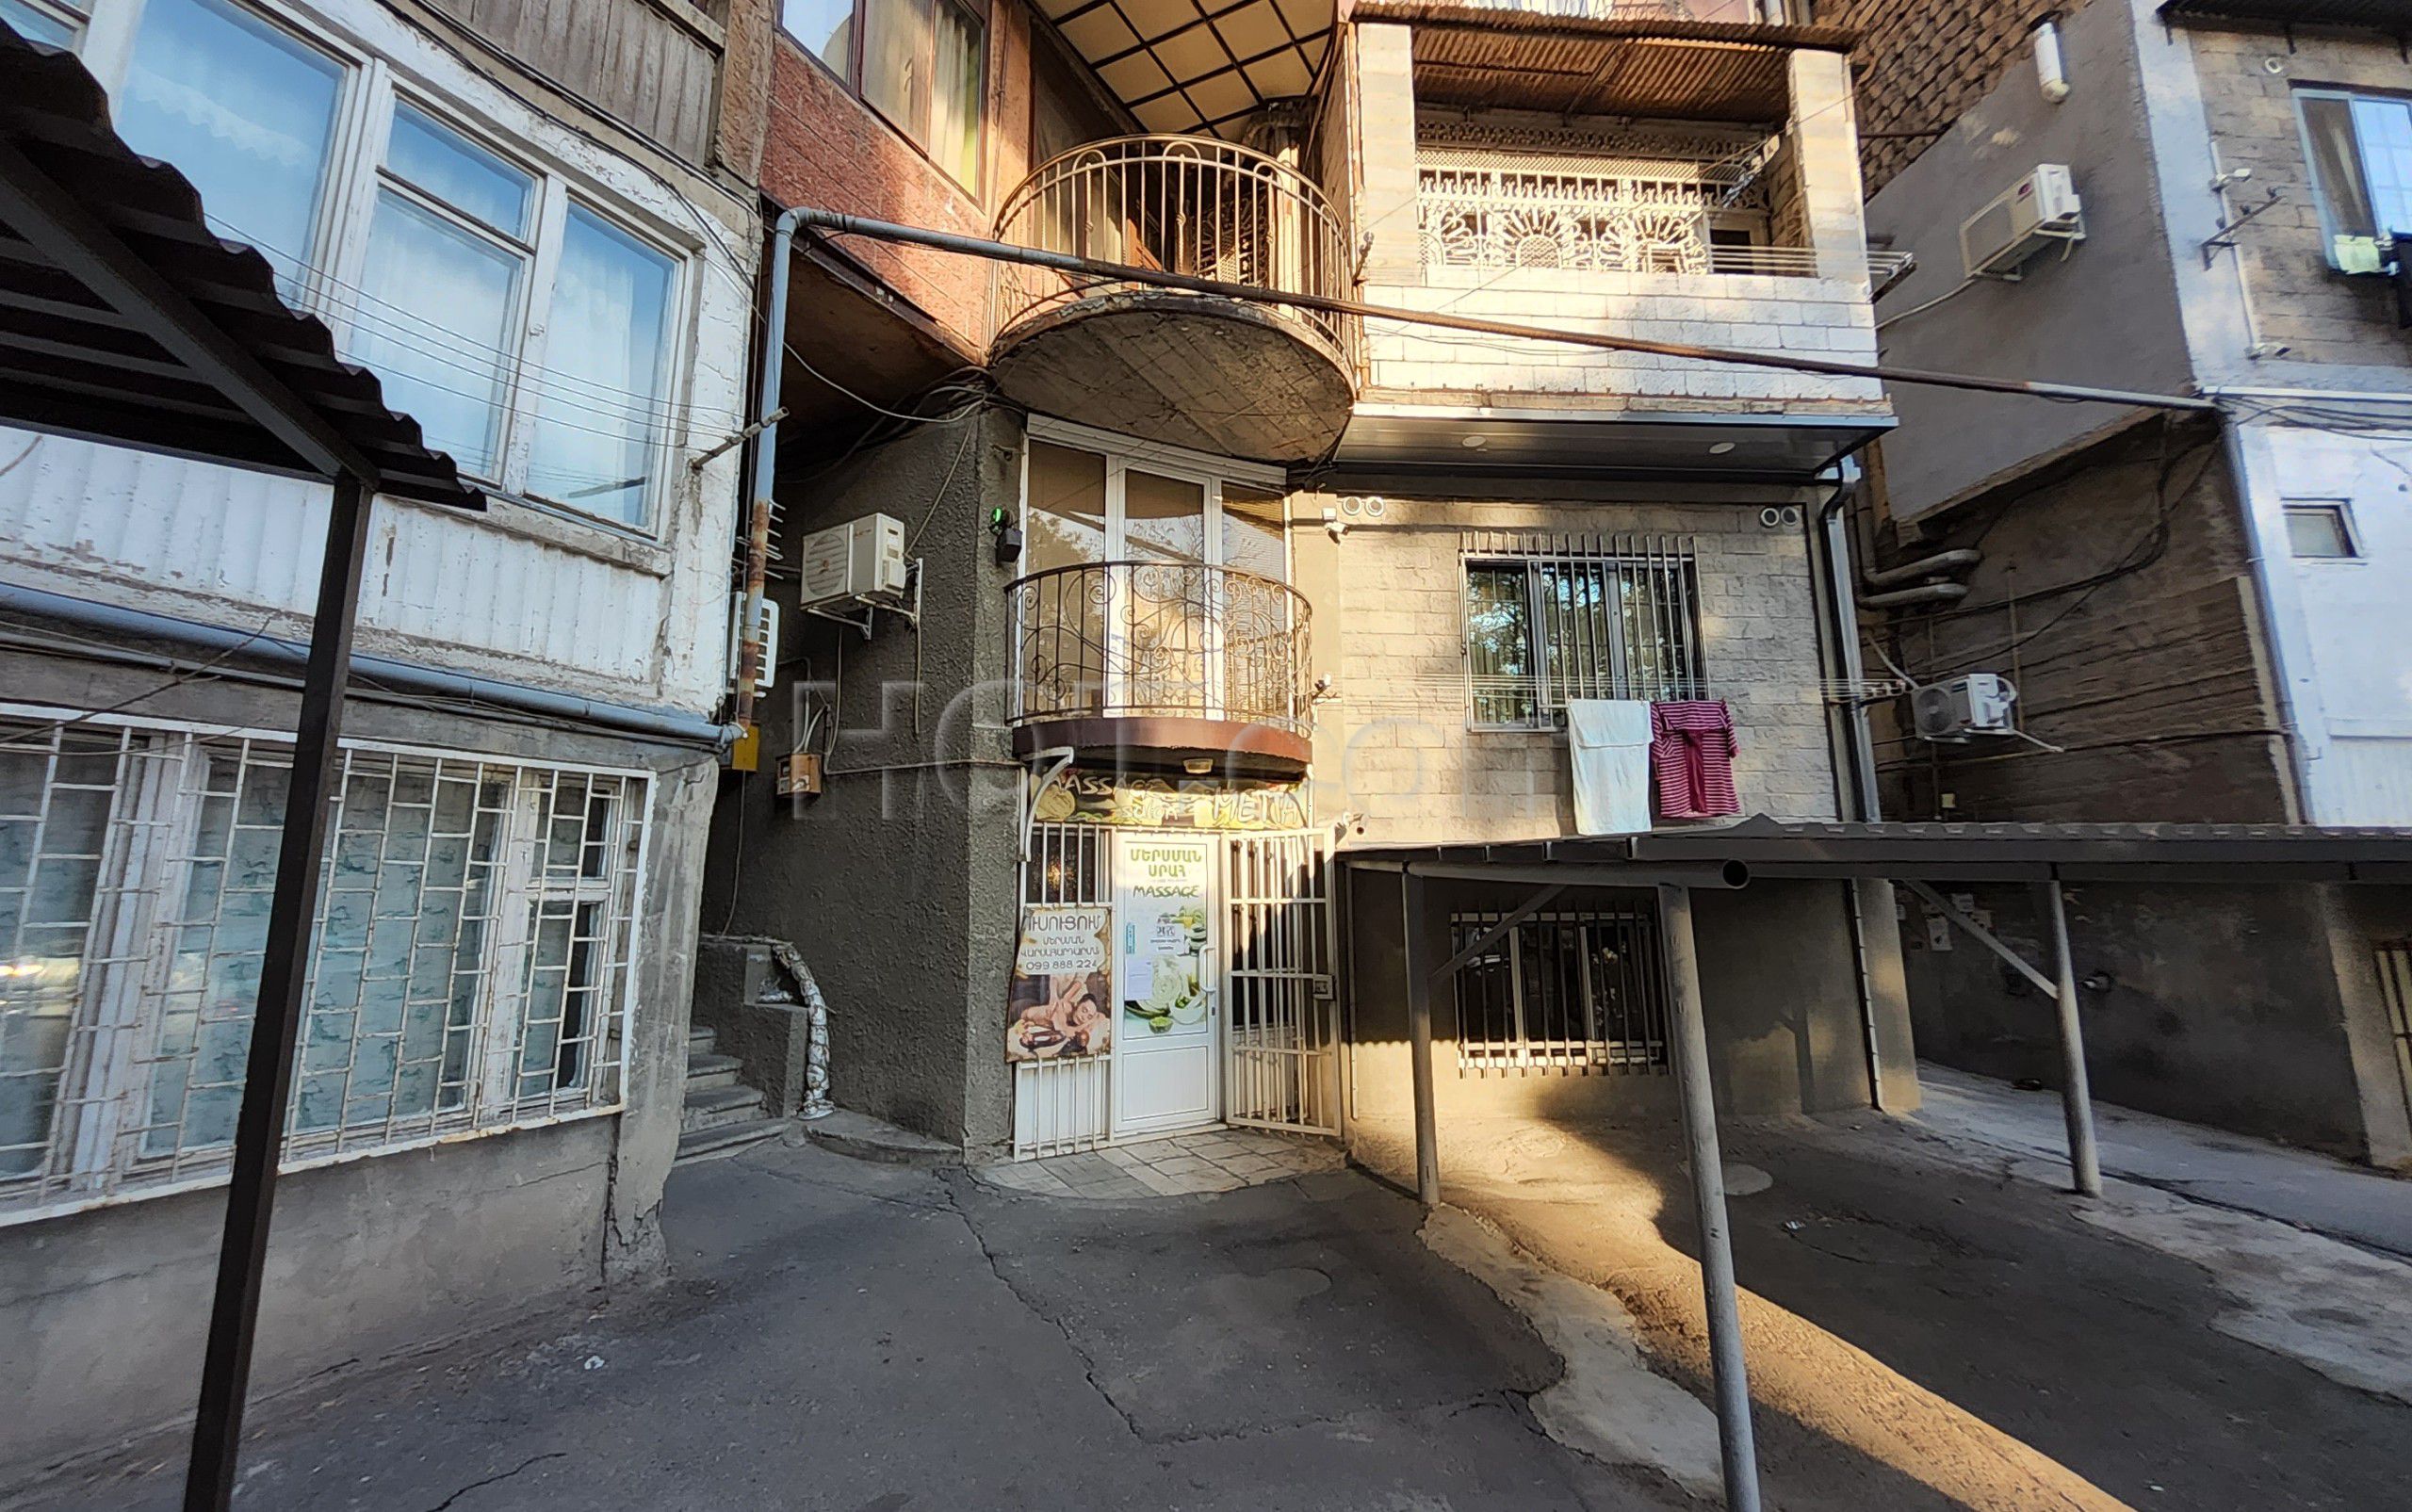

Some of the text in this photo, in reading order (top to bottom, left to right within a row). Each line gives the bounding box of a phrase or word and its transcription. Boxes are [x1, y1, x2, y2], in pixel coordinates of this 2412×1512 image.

[1213, 786, 1299, 823] METTA
[1131, 848, 1201, 862] ՄԵՐՍՄԱՆ
[1149, 864, 1186, 877] ՍՐԱՀ
[1133, 885, 1199, 898] MASSAGE
[1026, 961, 1050, 970] 099
[1052, 960, 1073, 969] 888
